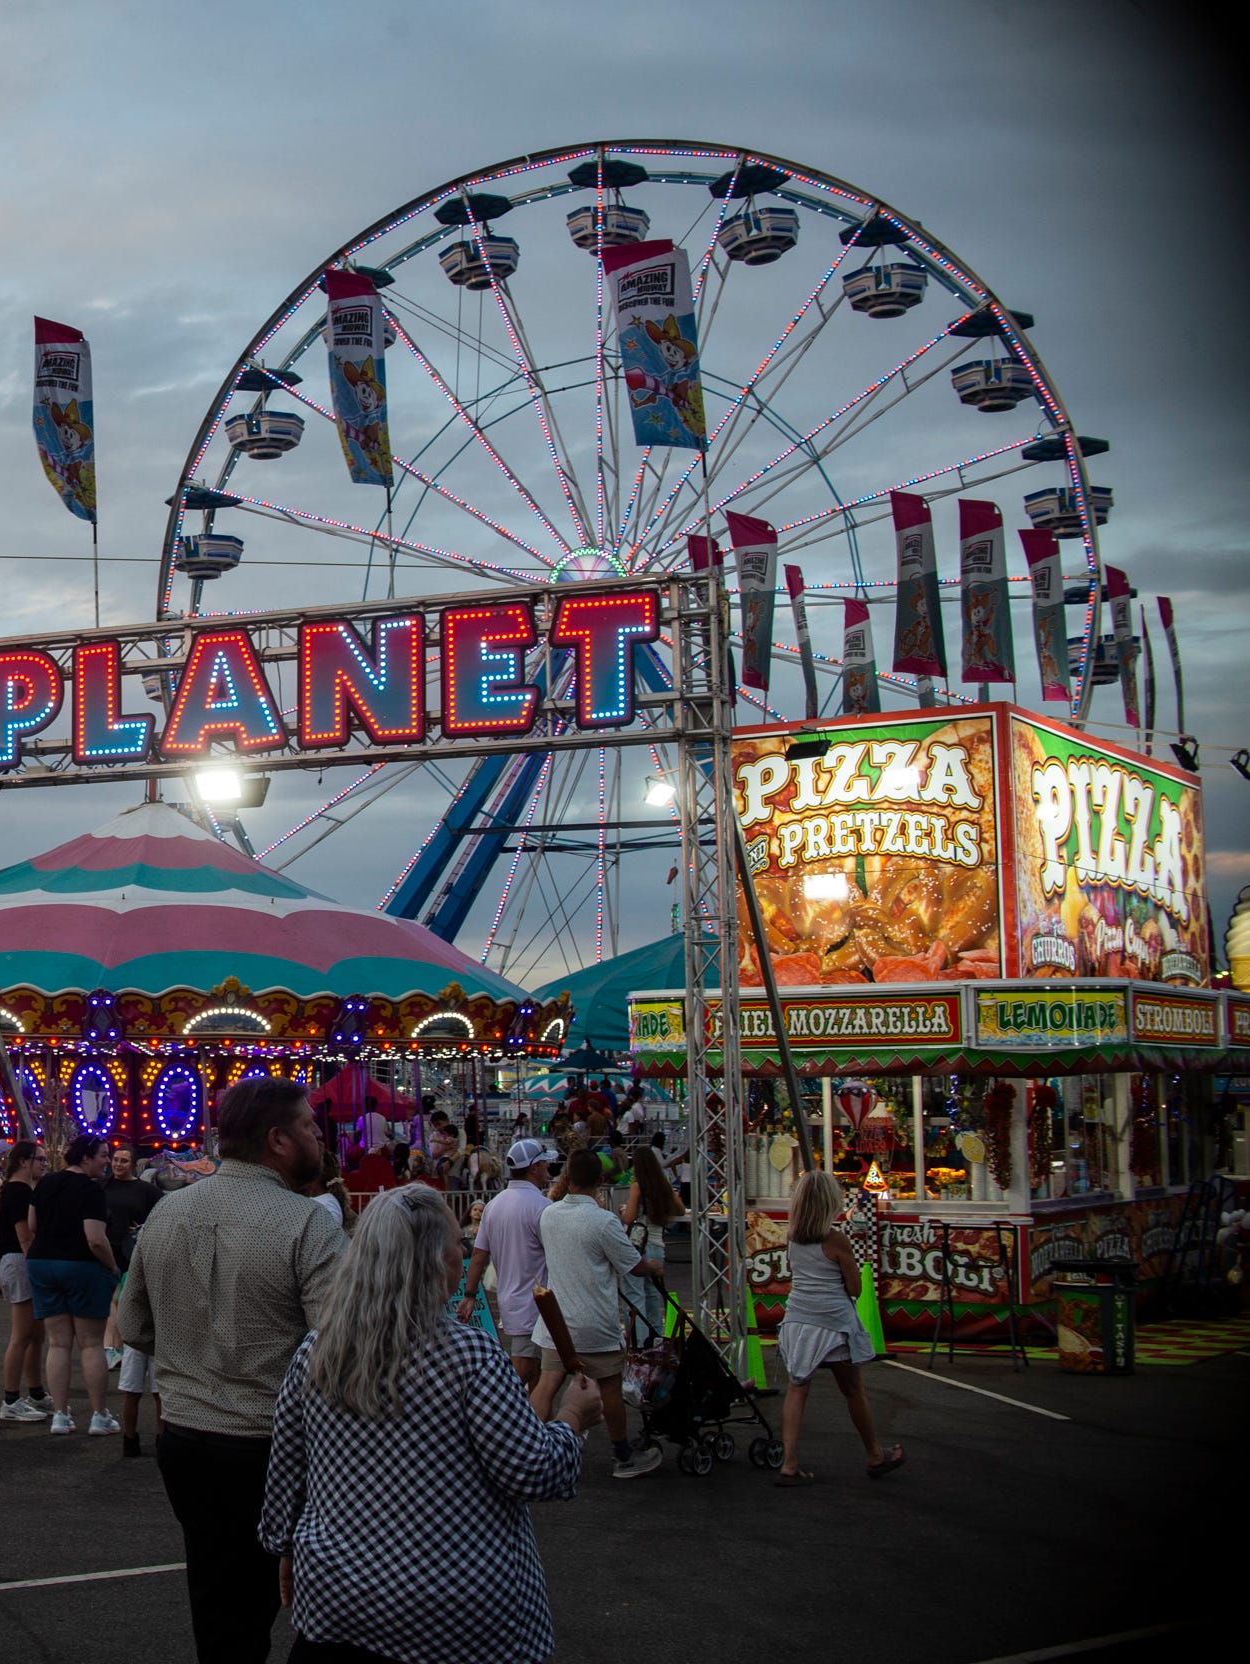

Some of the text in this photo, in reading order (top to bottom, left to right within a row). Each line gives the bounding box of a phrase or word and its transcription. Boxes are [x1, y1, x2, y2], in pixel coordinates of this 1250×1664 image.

[620, 271, 669, 294] AMAZING
[636, 283, 668, 295] MIDWAY
[331, 311, 370, 326] MAZING
[41, 357, 76, 370] AMAZING
[737, 741, 982, 826] PIZZA
[780, 811, 980, 867] PRETZELS
[1032, 761, 1188, 922] PIZZA
[1031, 935, 1077, 974] CHURROS
[788, 1005, 950, 1038] MOZZARELLA
[996, 1000, 1118, 1032] LEMONADE
[1136, 1003, 1215, 1035] STROMBOLI
[881, 1220, 938, 1246] Fresh
[1095, 1233, 1132, 1259] PIZZA
[1114, 1323, 1127, 1369] TASTY
